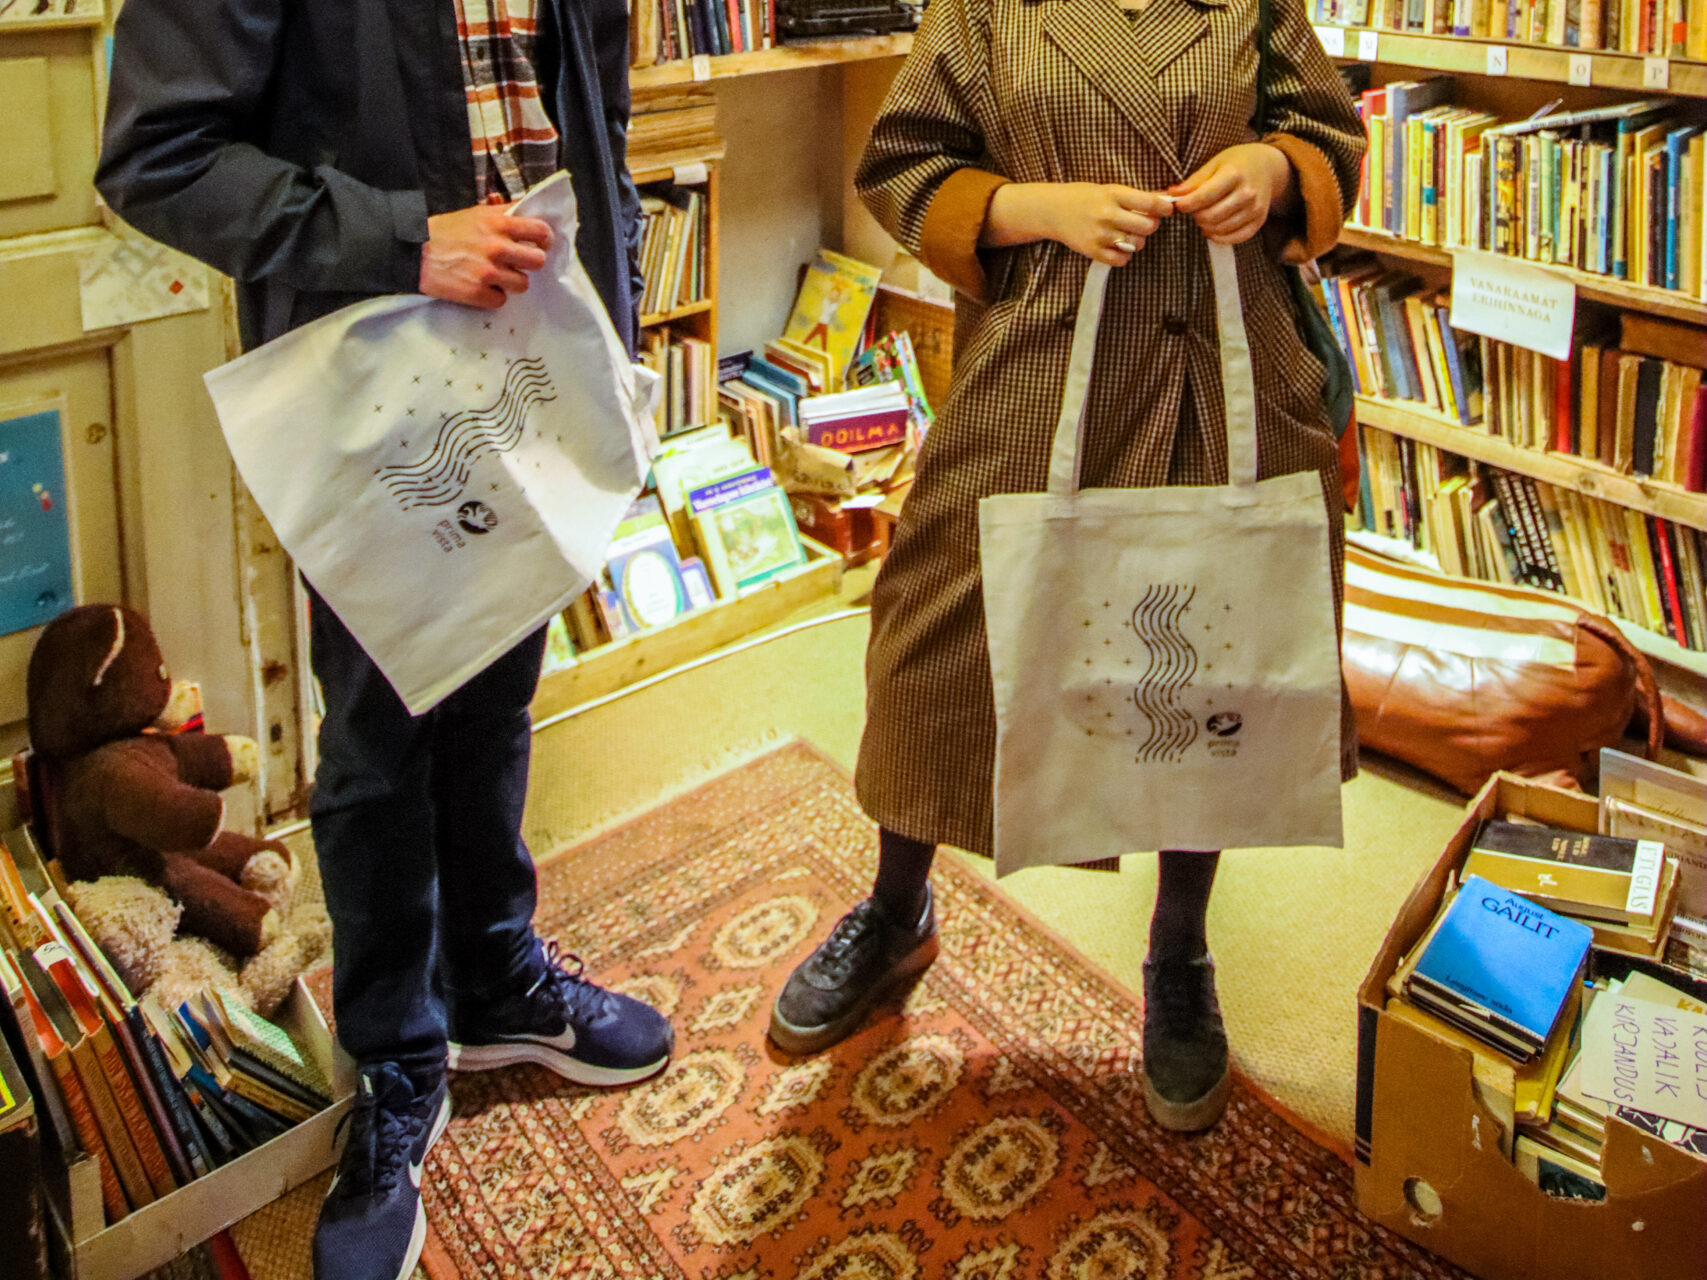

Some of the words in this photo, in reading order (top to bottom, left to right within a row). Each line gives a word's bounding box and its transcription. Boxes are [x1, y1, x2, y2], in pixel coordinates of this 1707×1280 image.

[1493, 56, 1502, 67] N
[1652, 68, 1662, 80] P
[1470, 276, 1558, 310] VANARAAMAT
[1472, 292, 1551, 324] ERIHINNAGA
[432, 529, 453, 553] vista
[436, 519, 466, 549] prima
[1207, 740, 1240, 750] prima
[1210, 749, 1237, 758] vista
[1481, 896, 1560, 939] GAILIT
[1504, 897, 1544, 920] August
[1612, 1002, 1641, 1103] KIRJANDUS
[1651, 1015, 1681, 1099] VAJALIK
